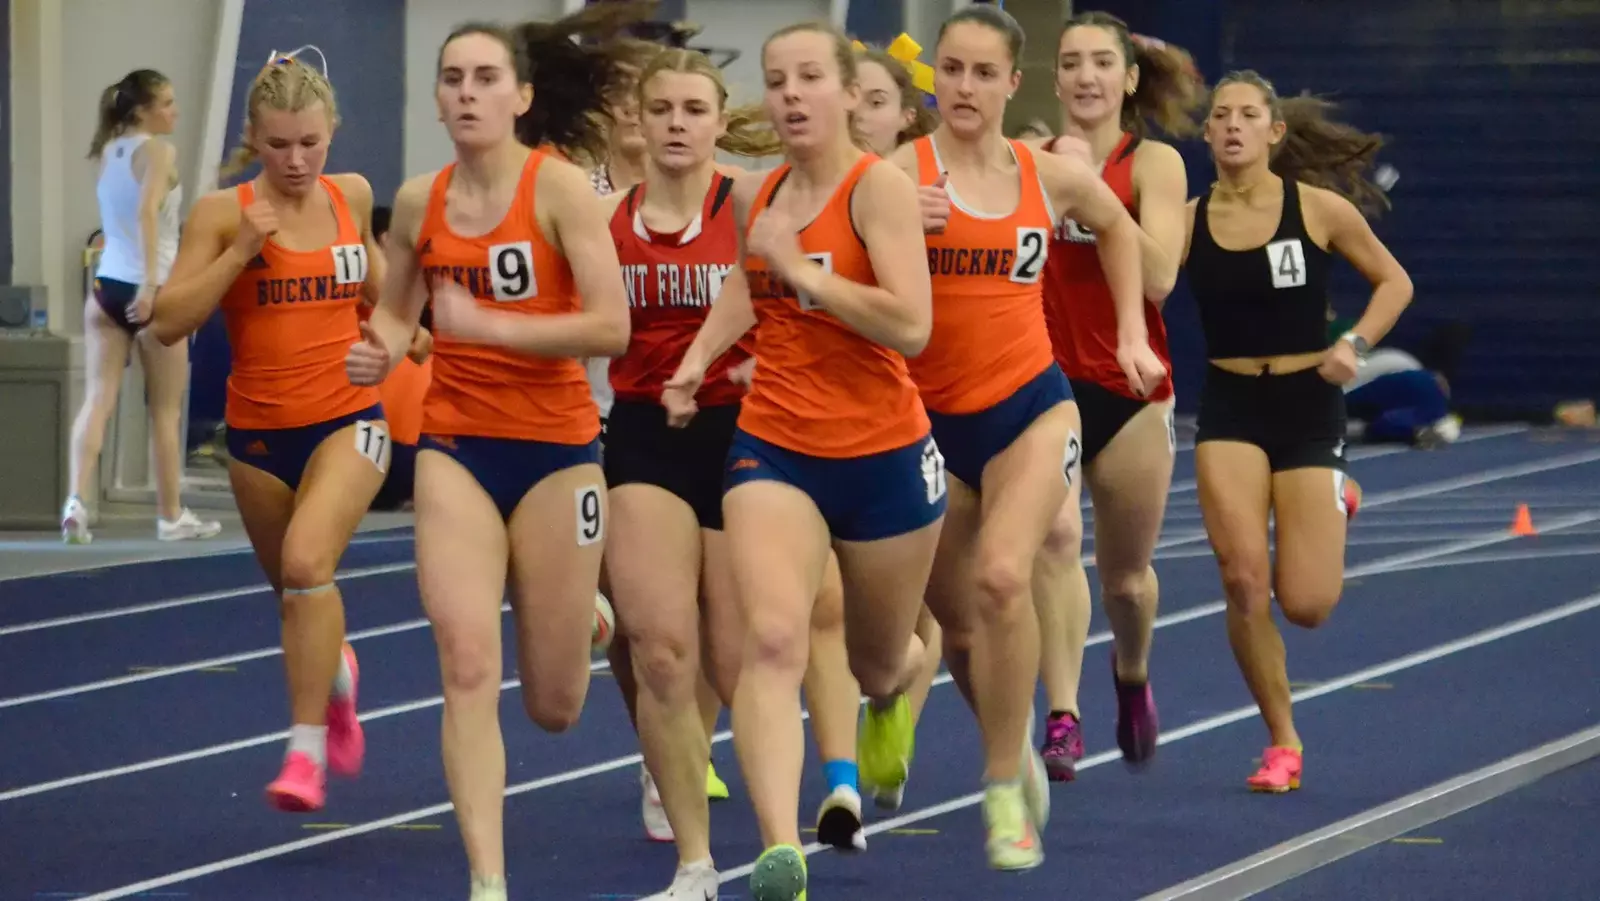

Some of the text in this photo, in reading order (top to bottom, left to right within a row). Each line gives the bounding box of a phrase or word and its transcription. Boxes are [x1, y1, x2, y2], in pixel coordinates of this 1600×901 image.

[336, 246, 362, 280] 11
[497, 247, 529, 296] 9
[1016, 231, 1043, 278] 2
[1279, 244, 1300, 283] 4
[656, 263, 735, 307] FRAN
[362, 426, 385, 464] 11
[1064, 437, 1079, 486] 2
[582, 490, 600, 540] 9
